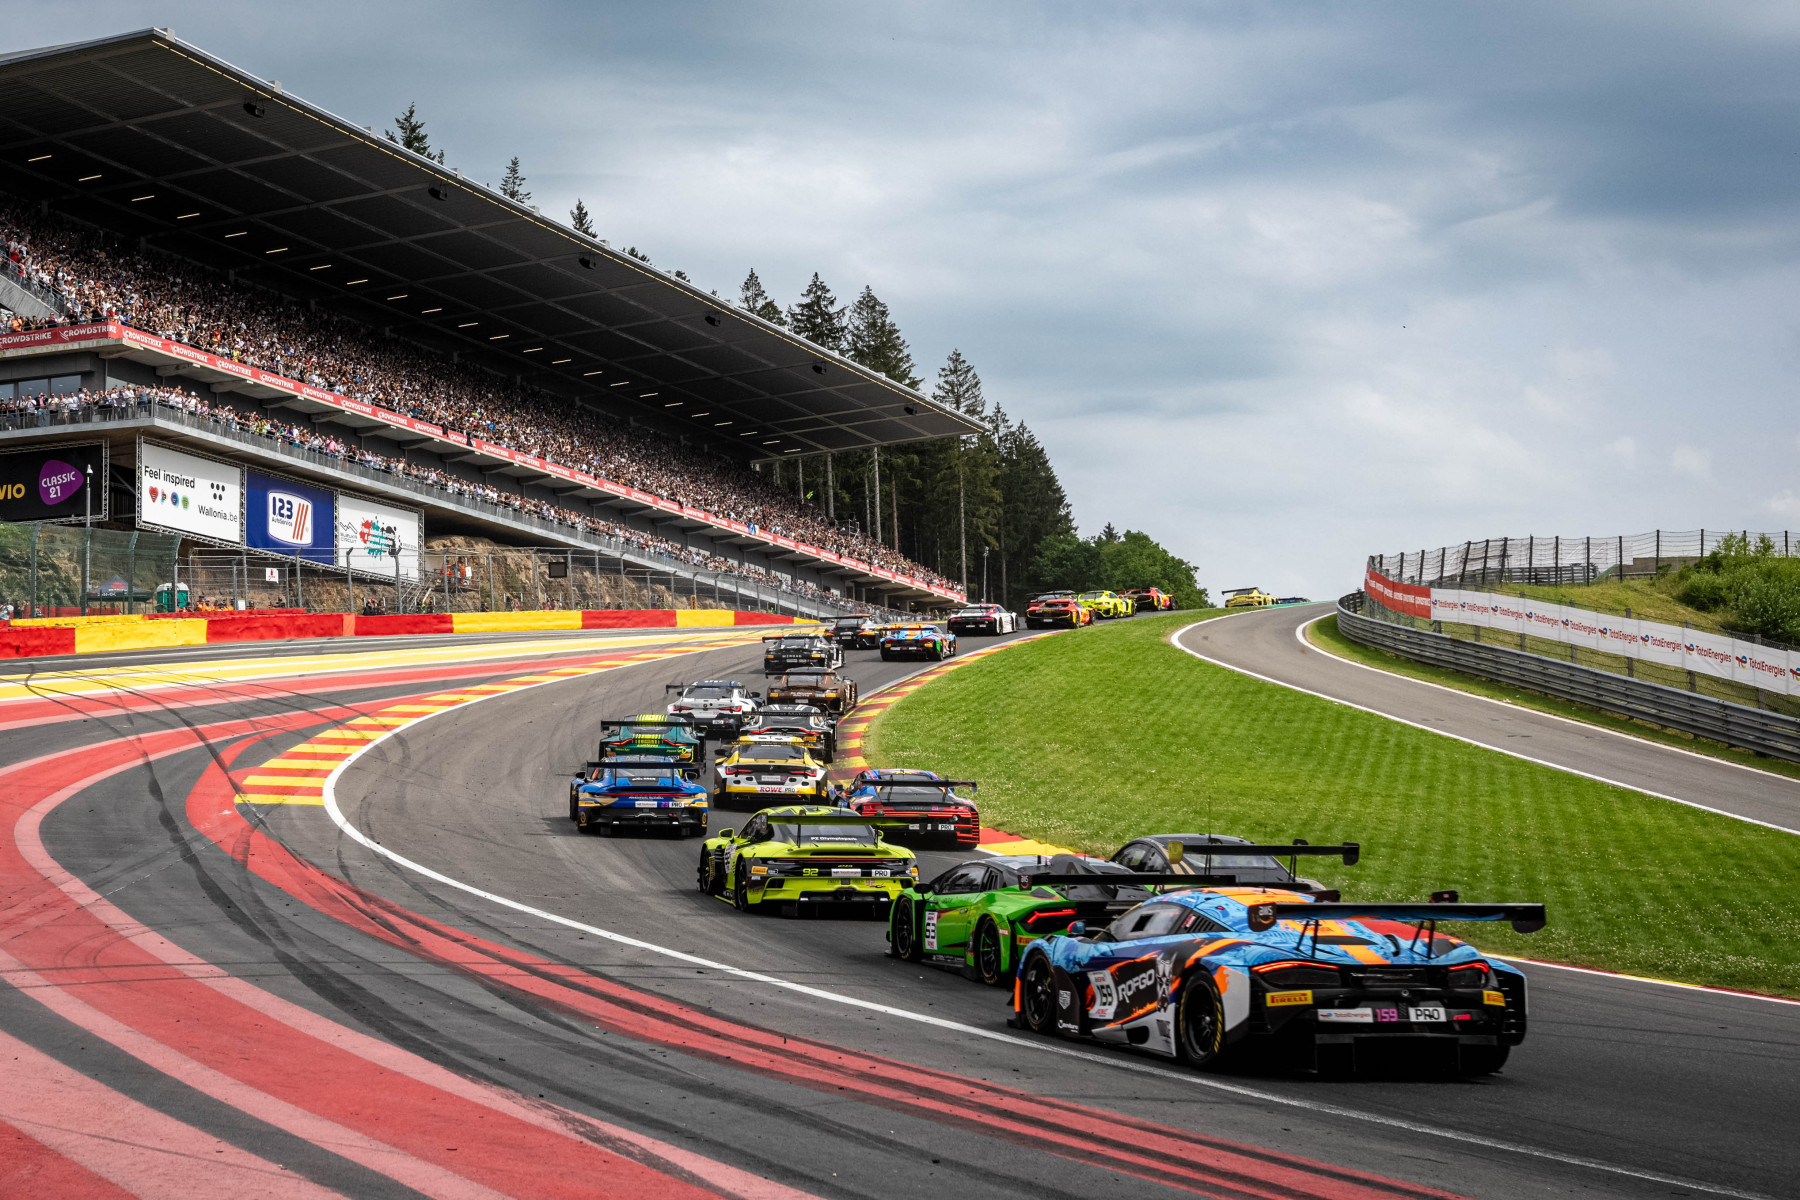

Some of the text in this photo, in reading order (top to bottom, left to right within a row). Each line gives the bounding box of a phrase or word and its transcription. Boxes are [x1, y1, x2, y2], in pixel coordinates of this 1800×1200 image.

[0, 332, 52, 345] ROWDSTRIKE
[63, 325, 117, 337] CROWDSTRIKE
[124, 329, 163, 348] CROWDSTRIKE
[173, 345, 208, 363] CROWDSTRIKE
[218, 359, 252, 376] CROWDSTRIKE
[261, 373, 294, 389] CROWDSTRIKE
[41, 471, 76, 488] CLASSIC
[144, 465, 195, 488] Feel inspired
[49, 485, 61, 498] 21
[198, 504, 238, 522] Wallonia.be
[272, 496, 293, 520] 123
[1498, 606, 1524, 620] TotalEnergies
[1533, 612, 1559, 628] TotalEnergies
[1569, 619, 1597, 636] TotalEnergies
[1608, 628, 1638, 644] TotalEnergies
[1650, 635, 1682, 653] TotalEnergies
[1695, 644, 1732, 664] TotalEnergies
[1748, 657, 1786, 678] TotalEnergies
[803, 868, 819, 877] 92
[925, 922, 936, 940] 63
[1117, 968, 1156, 1004] ROFGO
[1096, 984, 1114, 1007] 159
[1270, 993, 1308, 1004] PIRELLI
[1376, 1008, 1398, 1022] 159
[1414, 1008, 1441, 1021] PRO
